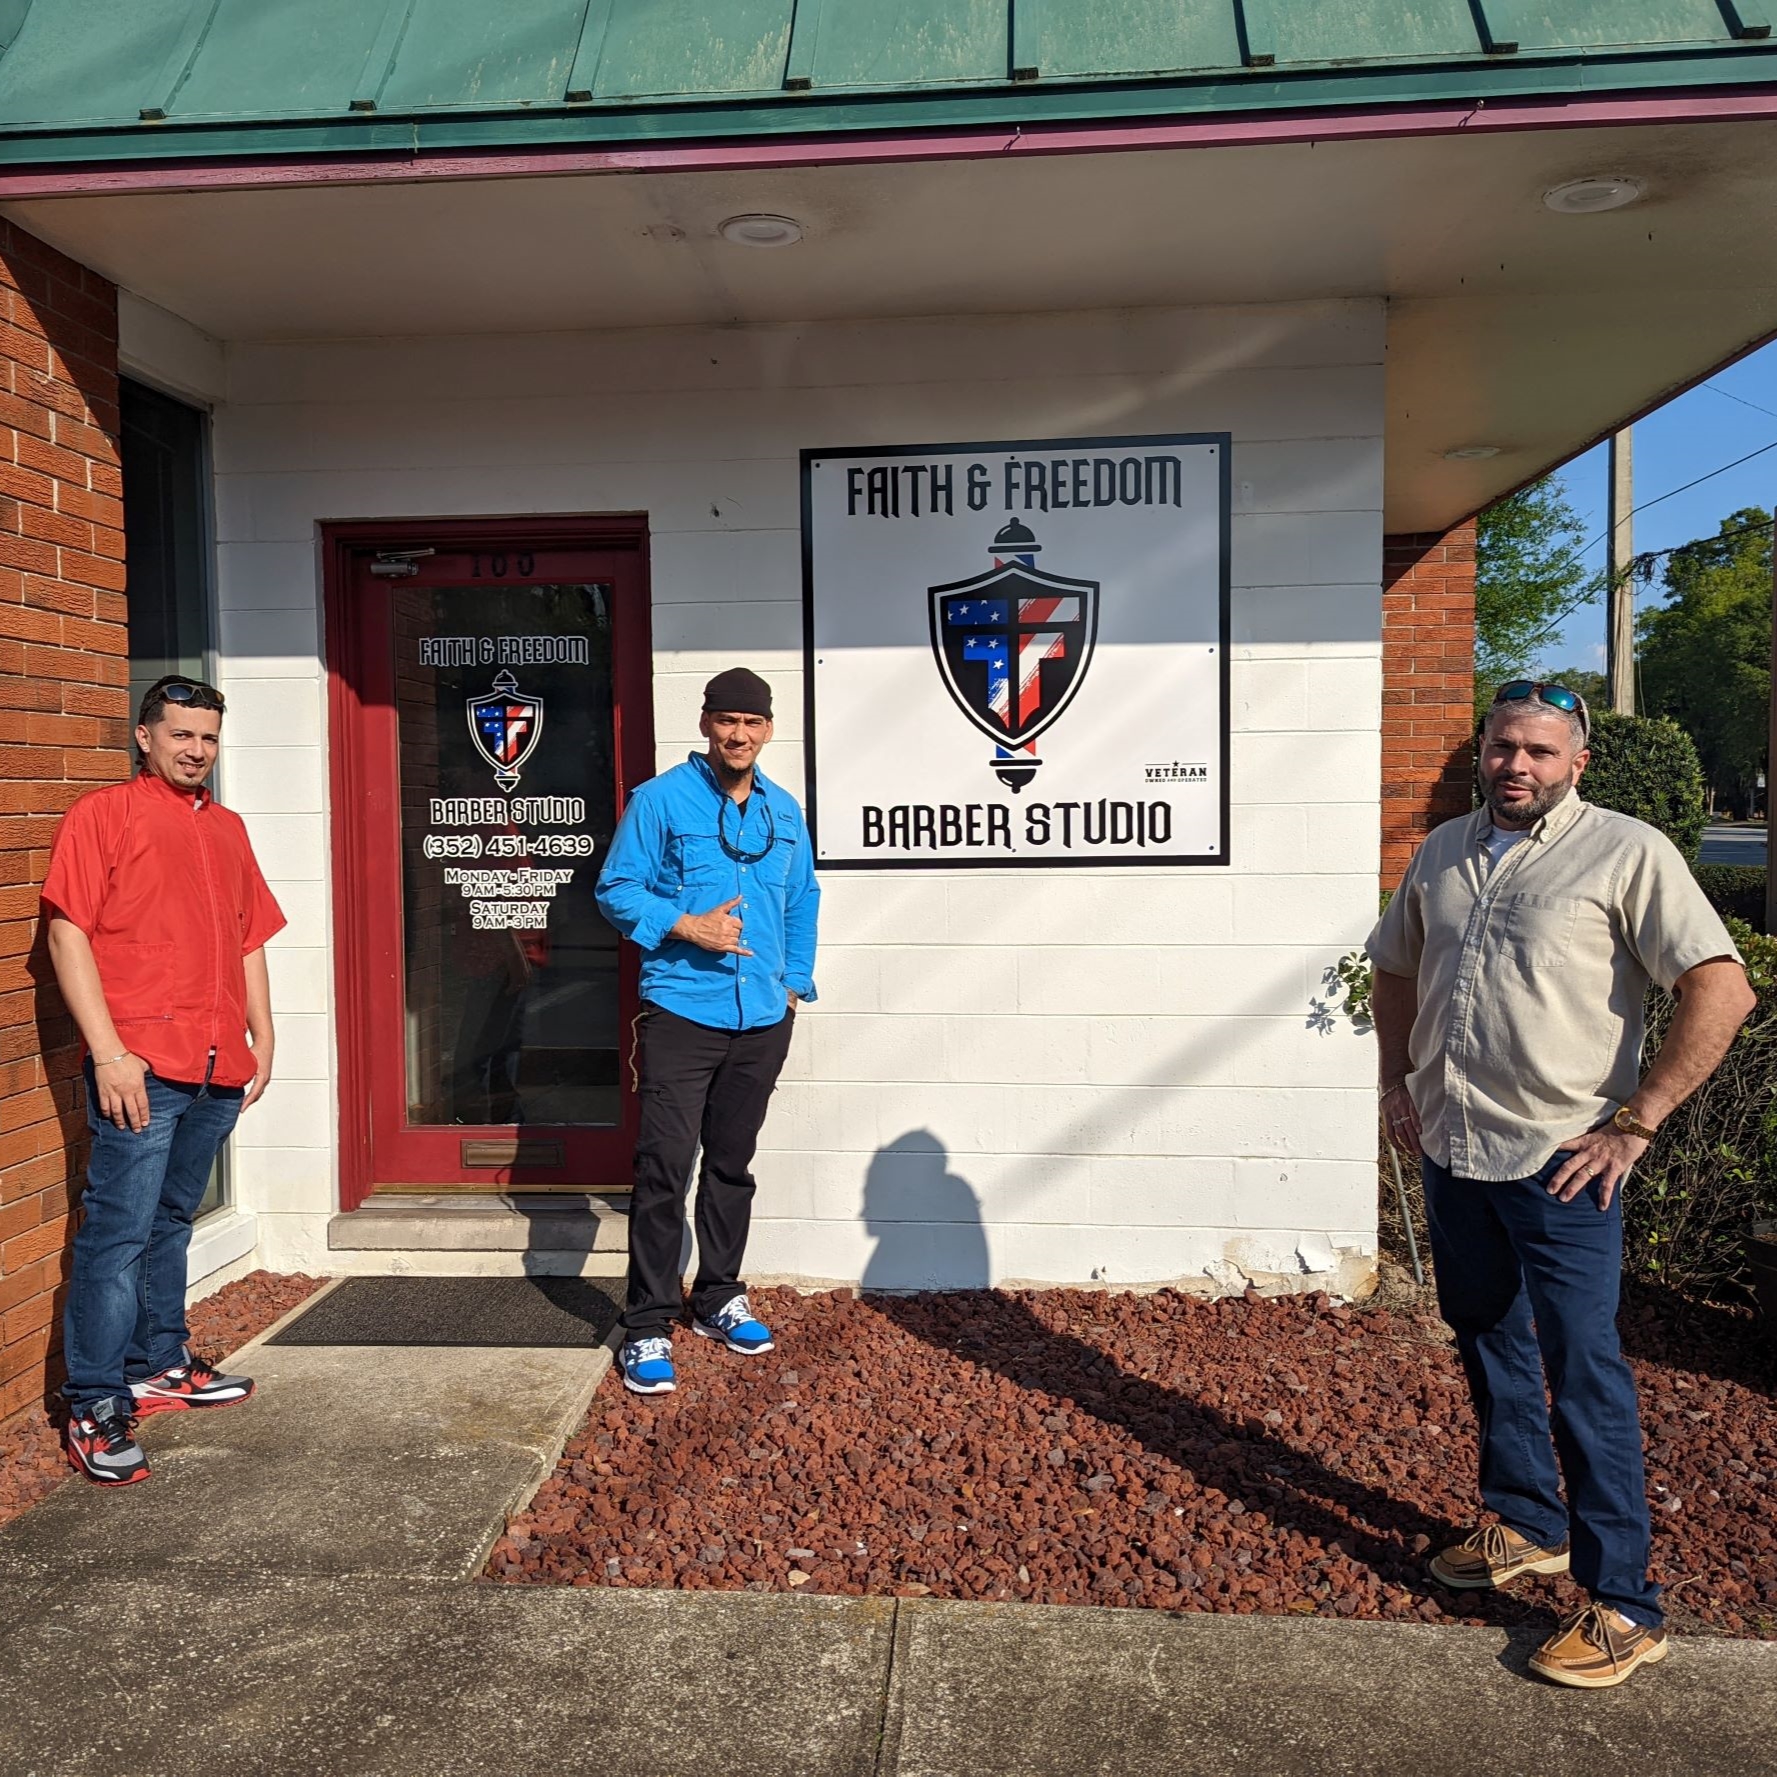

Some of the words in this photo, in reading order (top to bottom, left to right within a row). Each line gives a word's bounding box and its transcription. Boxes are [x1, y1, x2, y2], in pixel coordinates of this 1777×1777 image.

[847, 463, 954, 519] FAITH
[966, 463, 991, 512] &
[1004, 456, 1182, 513] FREEDOM
[419, 637, 476, 666] FAITH
[479, 637, 494, 665] &
[497, 636, 589, 666] FREEDOM
[1145, 768, 1207, 777] VETERAN
[430, 798, 508, 825] BARBER
[511, 796, 585, 825] STUDIO
[862, 803, 1011, 850] BARBER
[1025, 798, 1172, 848] STUDIO
[423, 834, 483, 859] (352)
[485, 835, 594, 856] 451-4639
